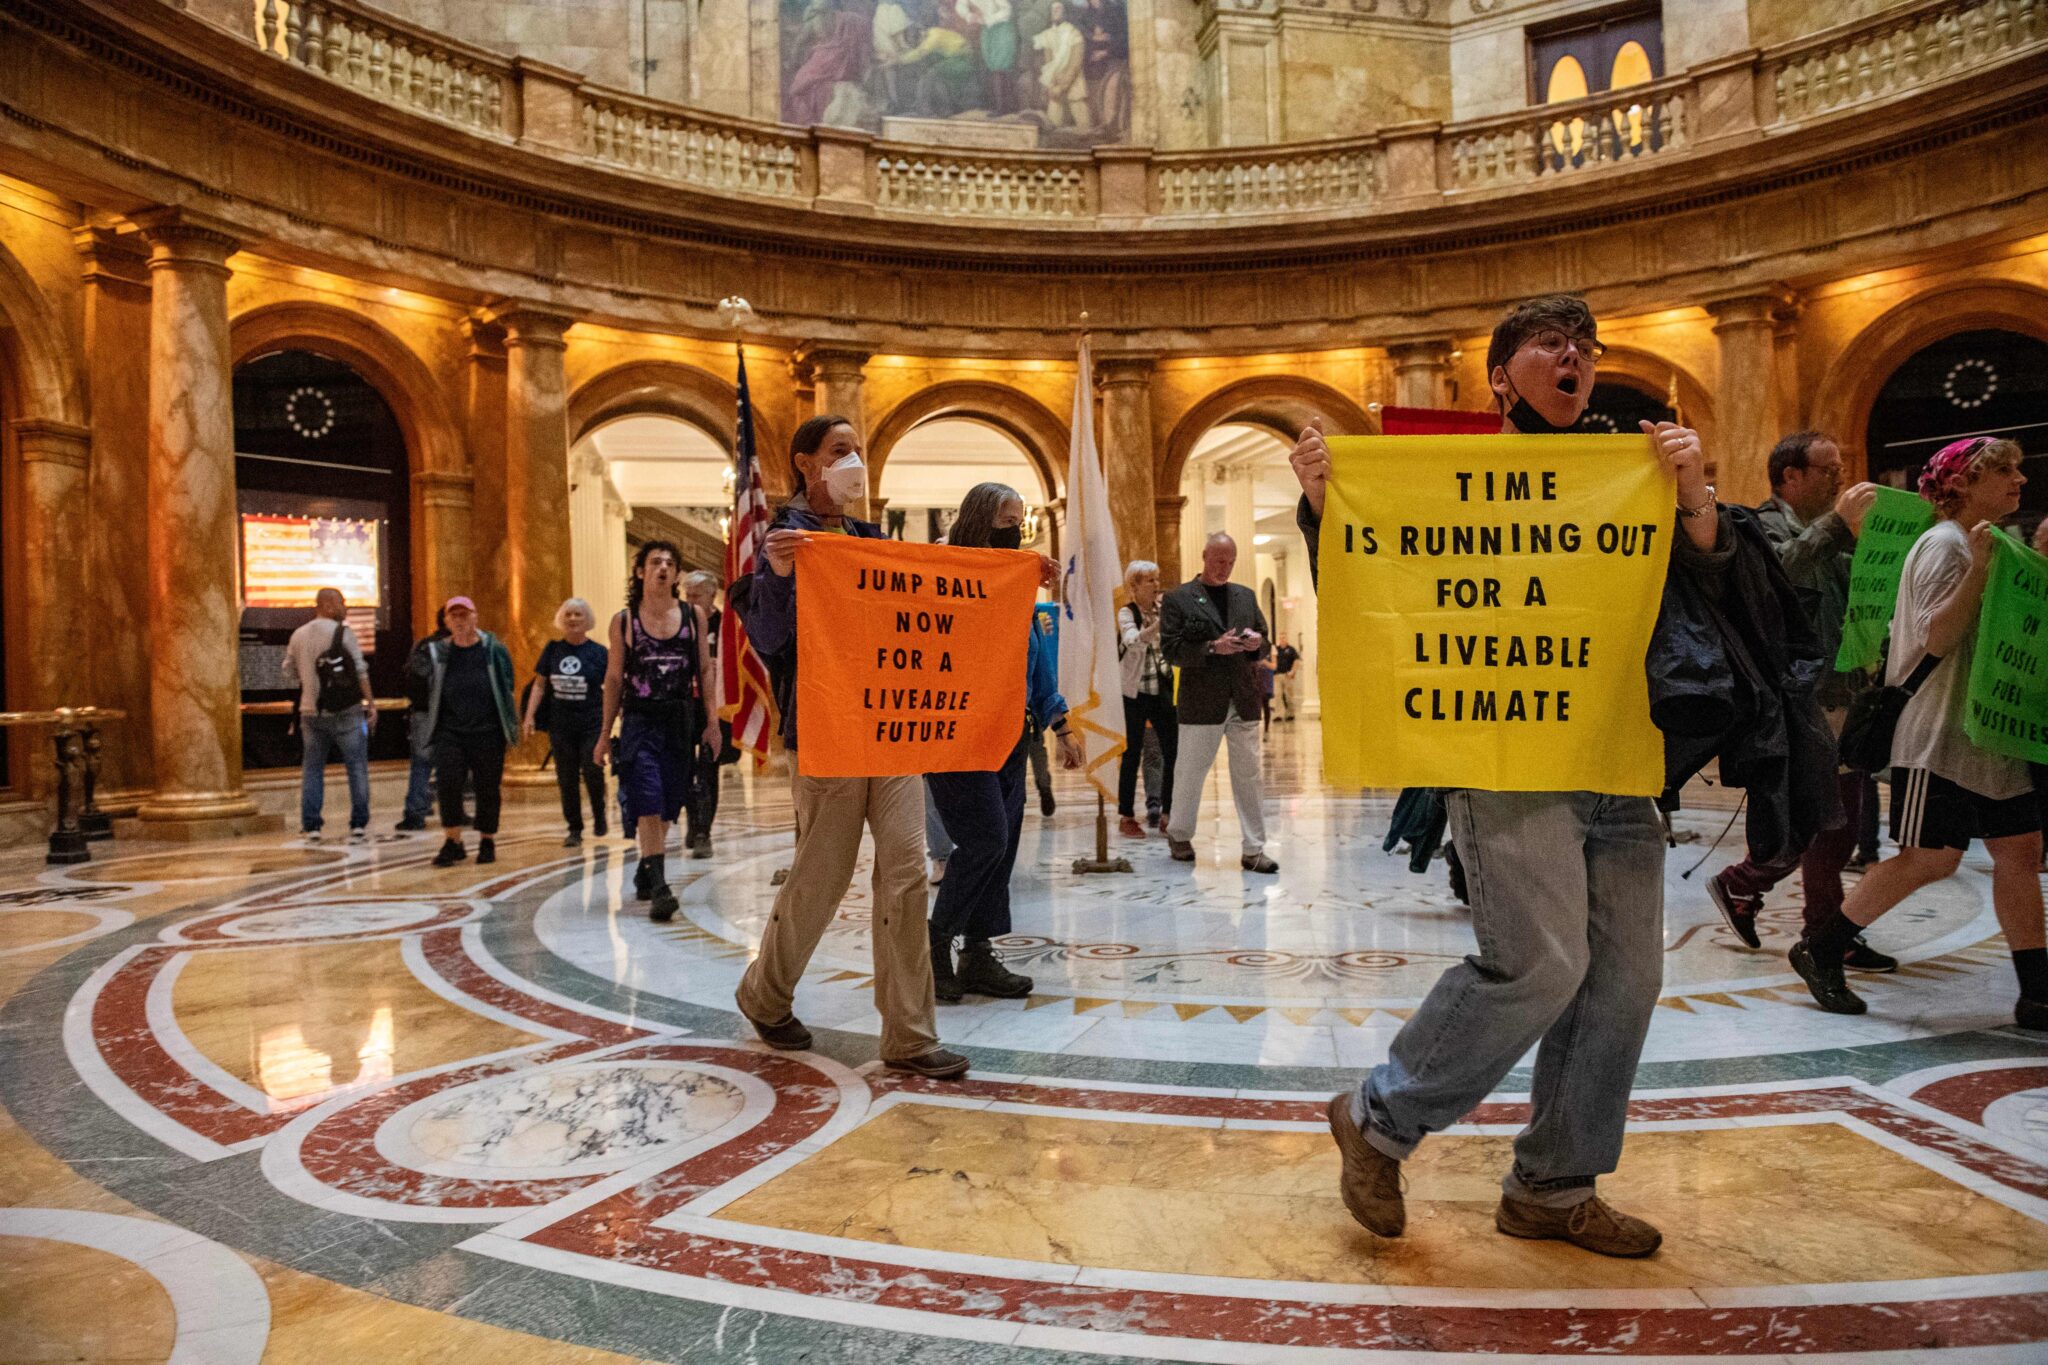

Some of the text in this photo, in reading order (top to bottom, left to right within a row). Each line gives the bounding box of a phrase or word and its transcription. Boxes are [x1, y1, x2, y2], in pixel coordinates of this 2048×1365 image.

[1455, 471, 1557, 502] TIME
[1344, 522, 1657, 556] IS RUNNING OUT
[857, 568, 987, 599] JUMP BALL
[1437, 576, 1547, 608] FOR A
[896, 611, 954, 635] NOW
[877, 648, 953, 672] FOR A
[1415, 632, 1591, 668] LIVEABLE
[1996, 641, 2038, 675] FOSSIL
[864, 688, 970, 711] LIVEABLE
[1404, 687, 1571, 722] CLIMATE
[1991, 678, 2021, 706] FUEL
[876, 720, 957, 742] FUTURE
